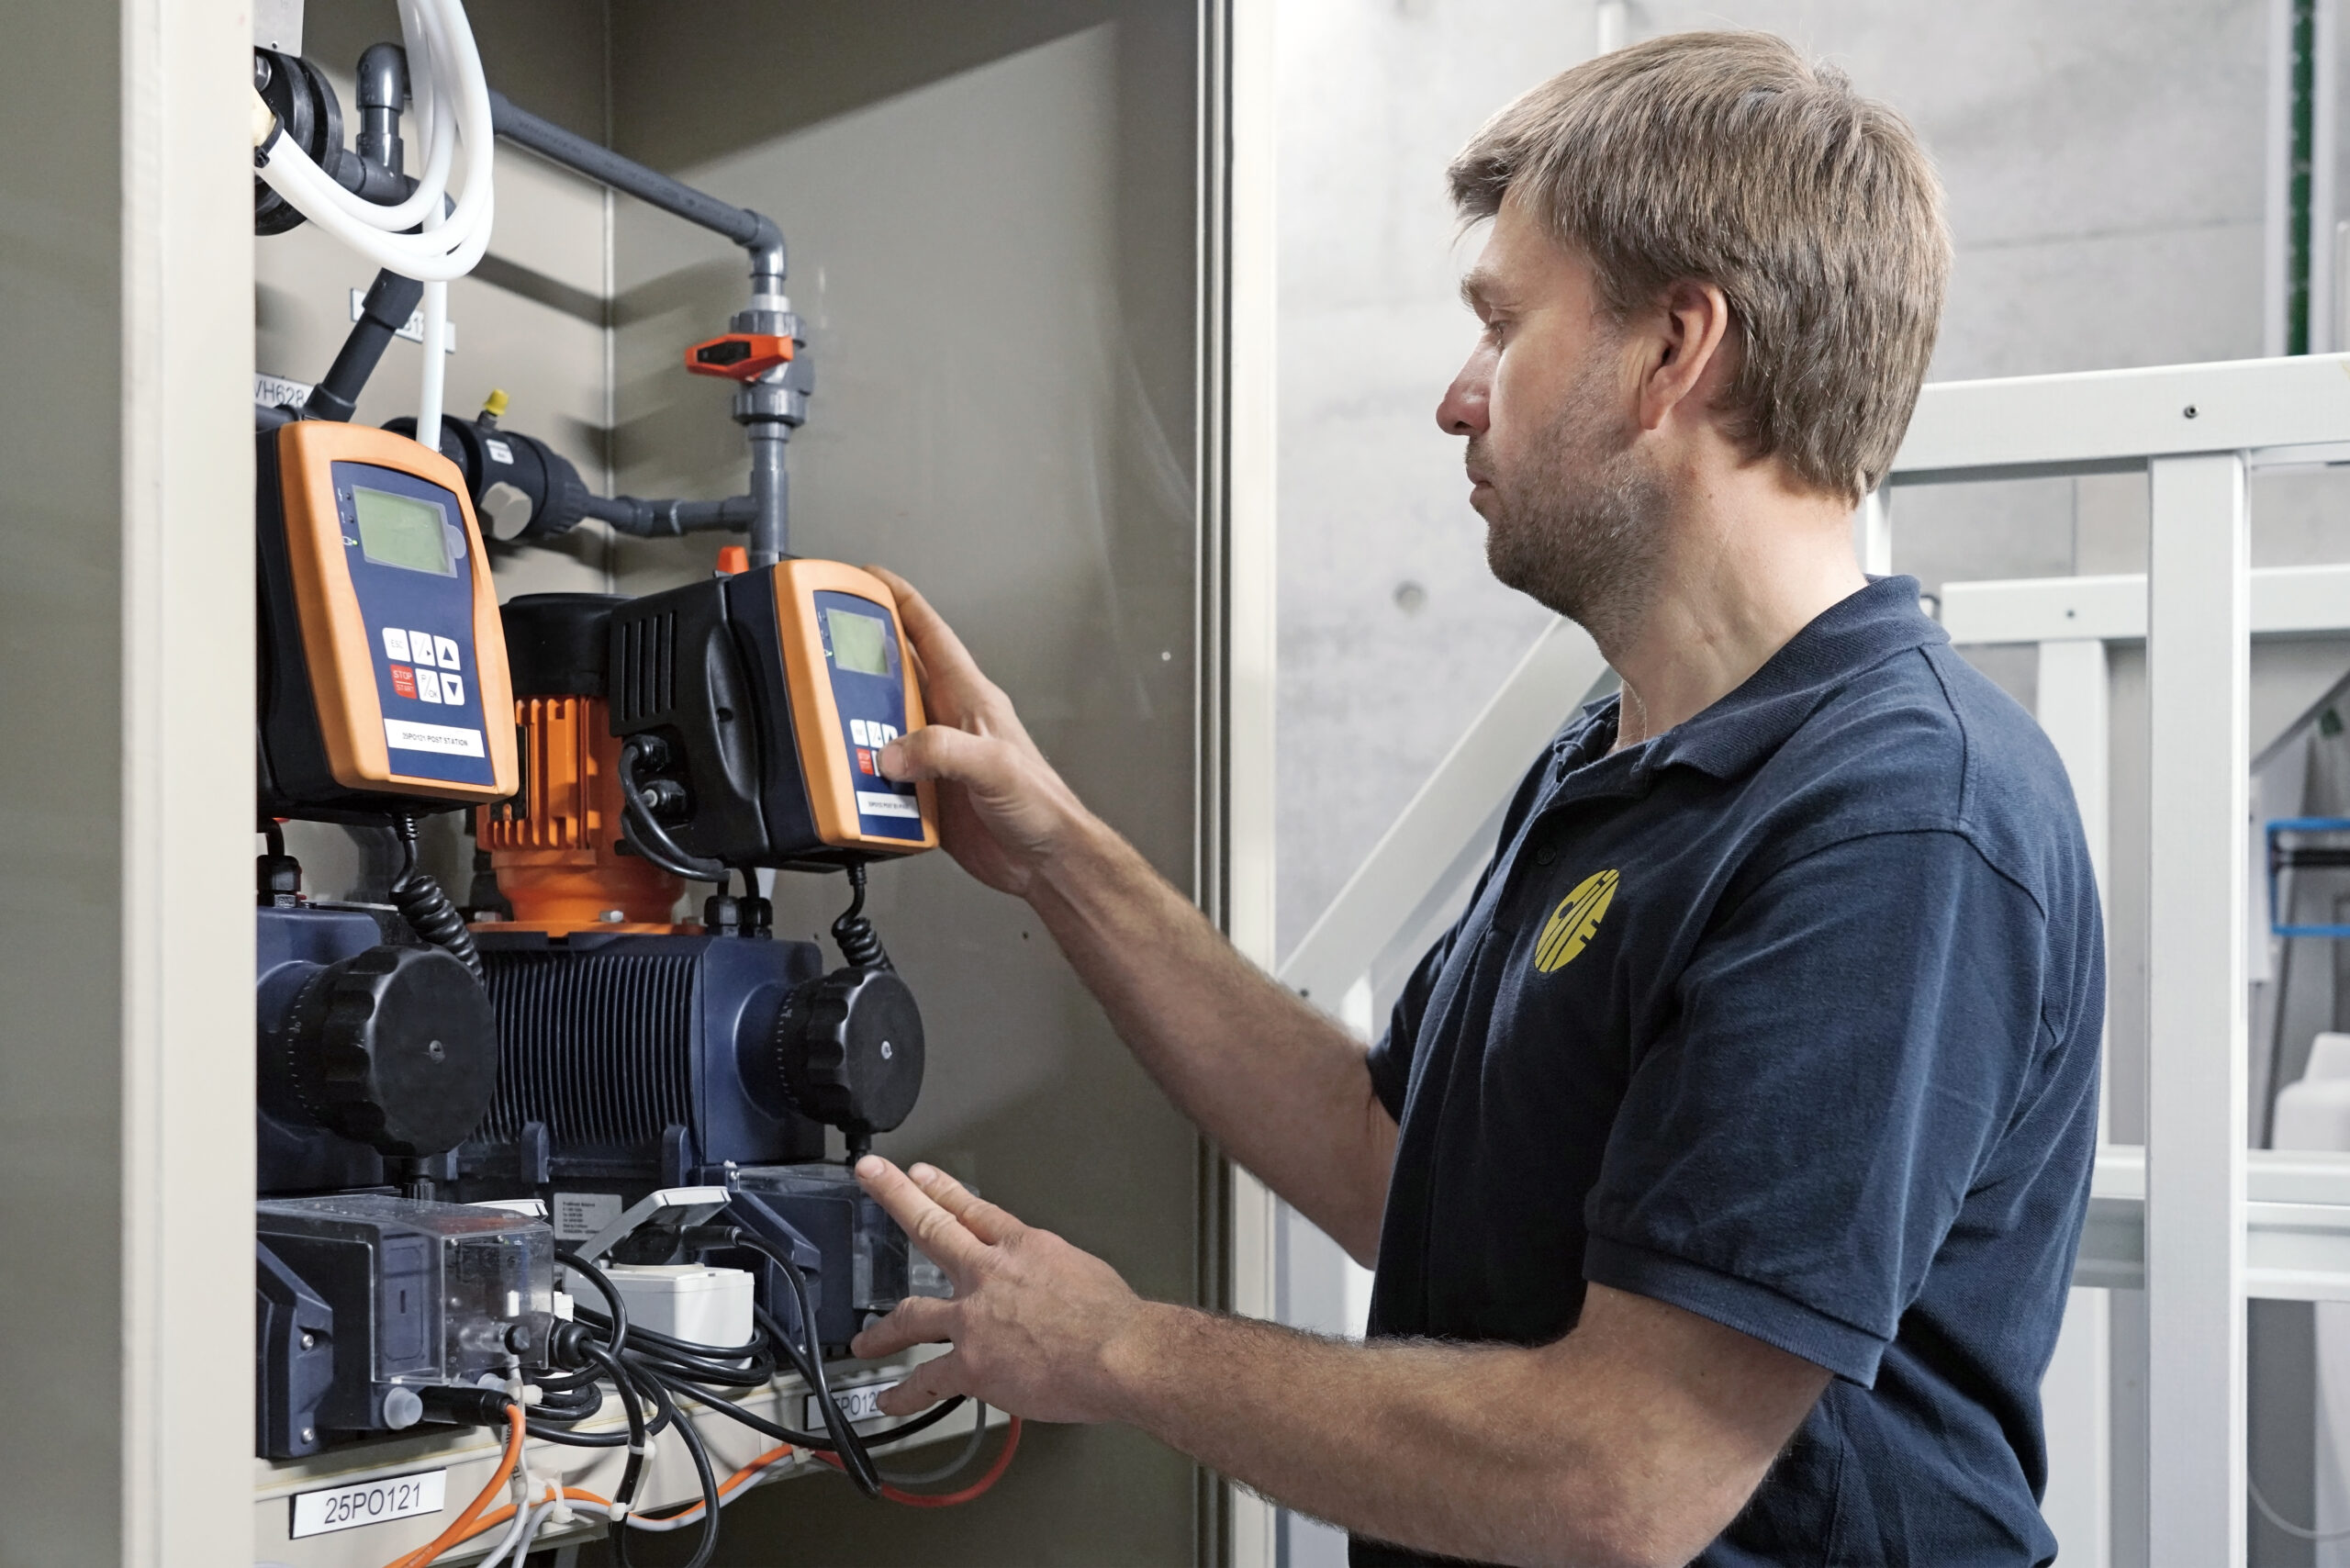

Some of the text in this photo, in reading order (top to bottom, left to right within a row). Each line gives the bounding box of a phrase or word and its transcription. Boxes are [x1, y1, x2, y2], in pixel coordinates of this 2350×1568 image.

[393, 670, 413, 680] STOP
[428, 689, 439, 699] OK
[427, 735, 442, 744] POST
[443, 737, 468, 746] STATION
[323, 1482, 421, 1525] 25PO121
